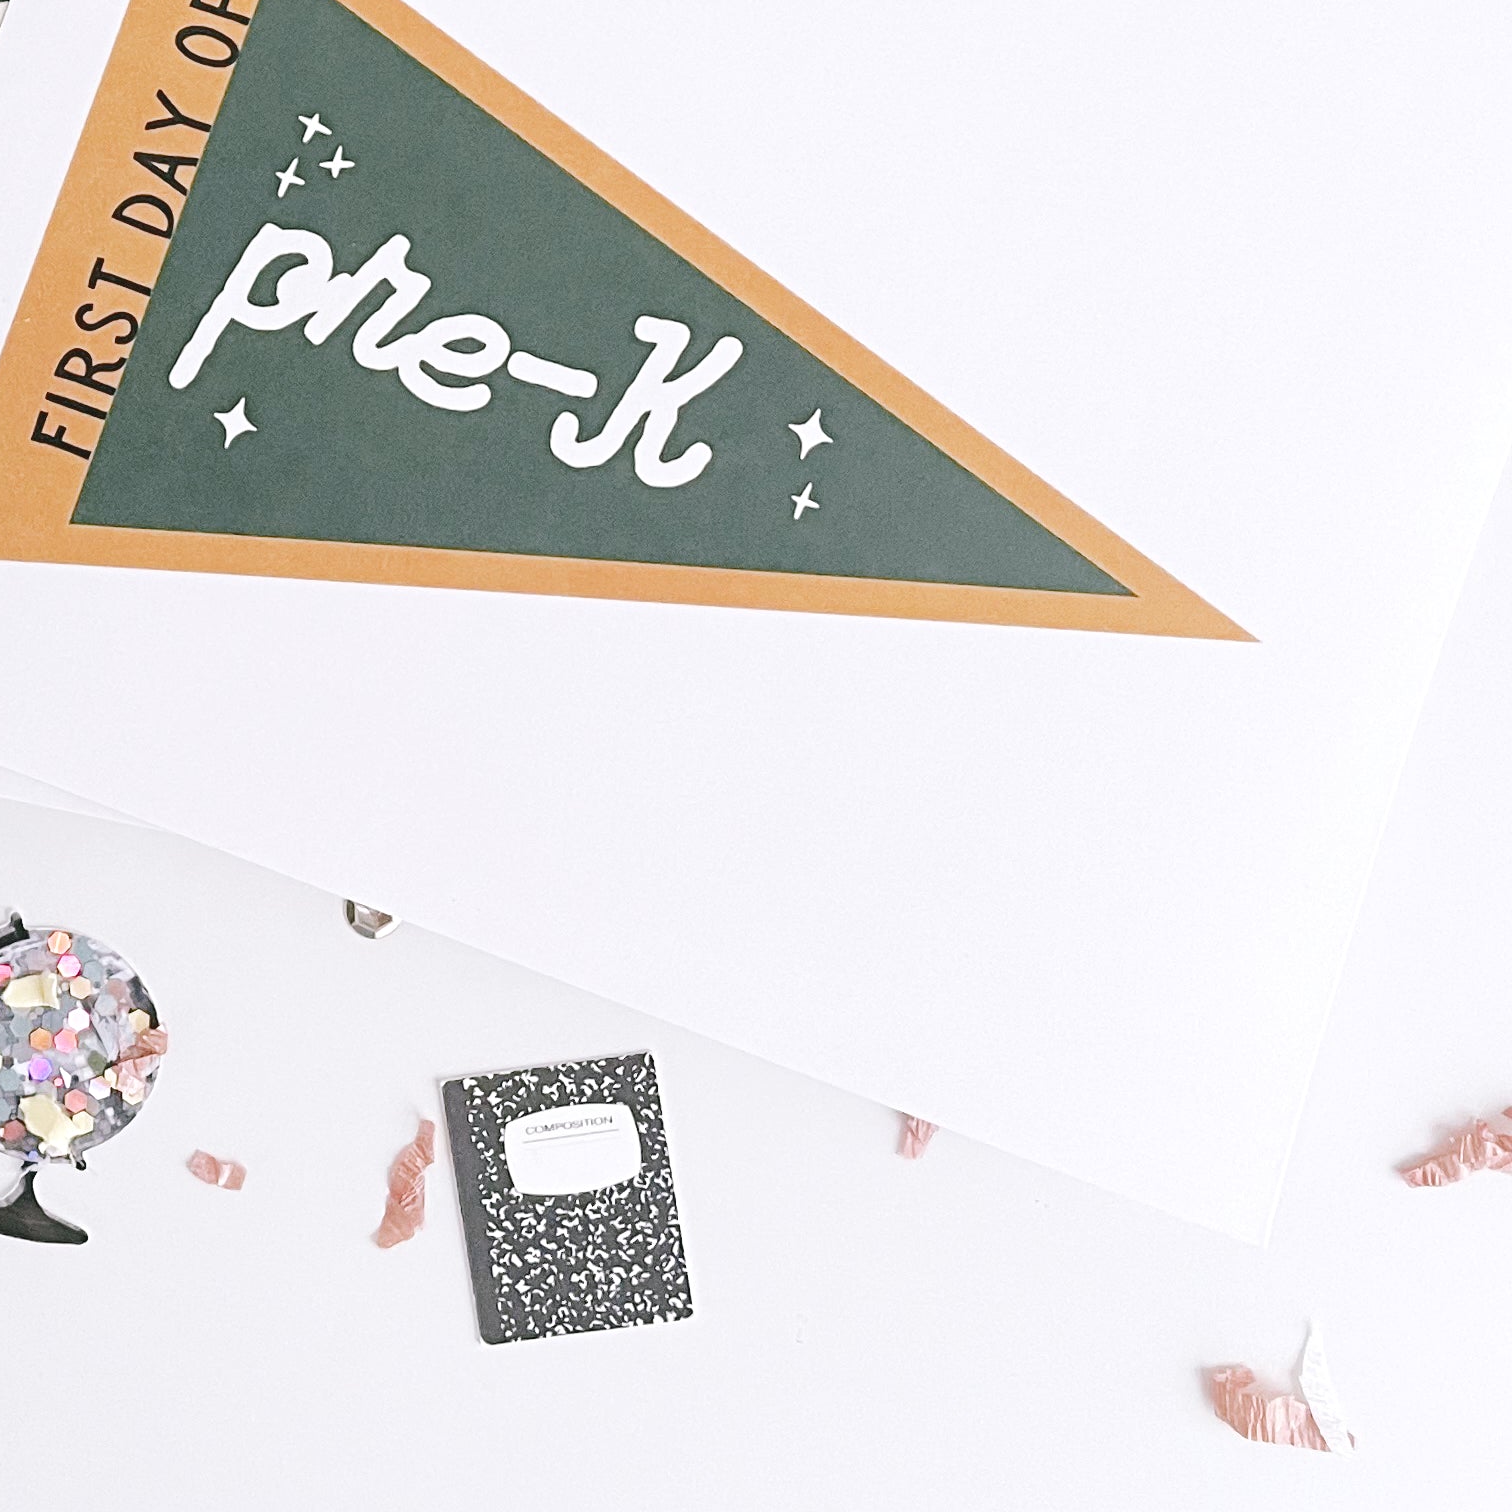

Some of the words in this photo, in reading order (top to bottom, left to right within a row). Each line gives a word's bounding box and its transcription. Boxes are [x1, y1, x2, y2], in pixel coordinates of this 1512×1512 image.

[31, 257, 152, 460] FIRST
[112, 89, 212, 239] DAY
[168, 222, 743, 488] pre-K
[525, 1115, 613, 1135] COMPOSITION
